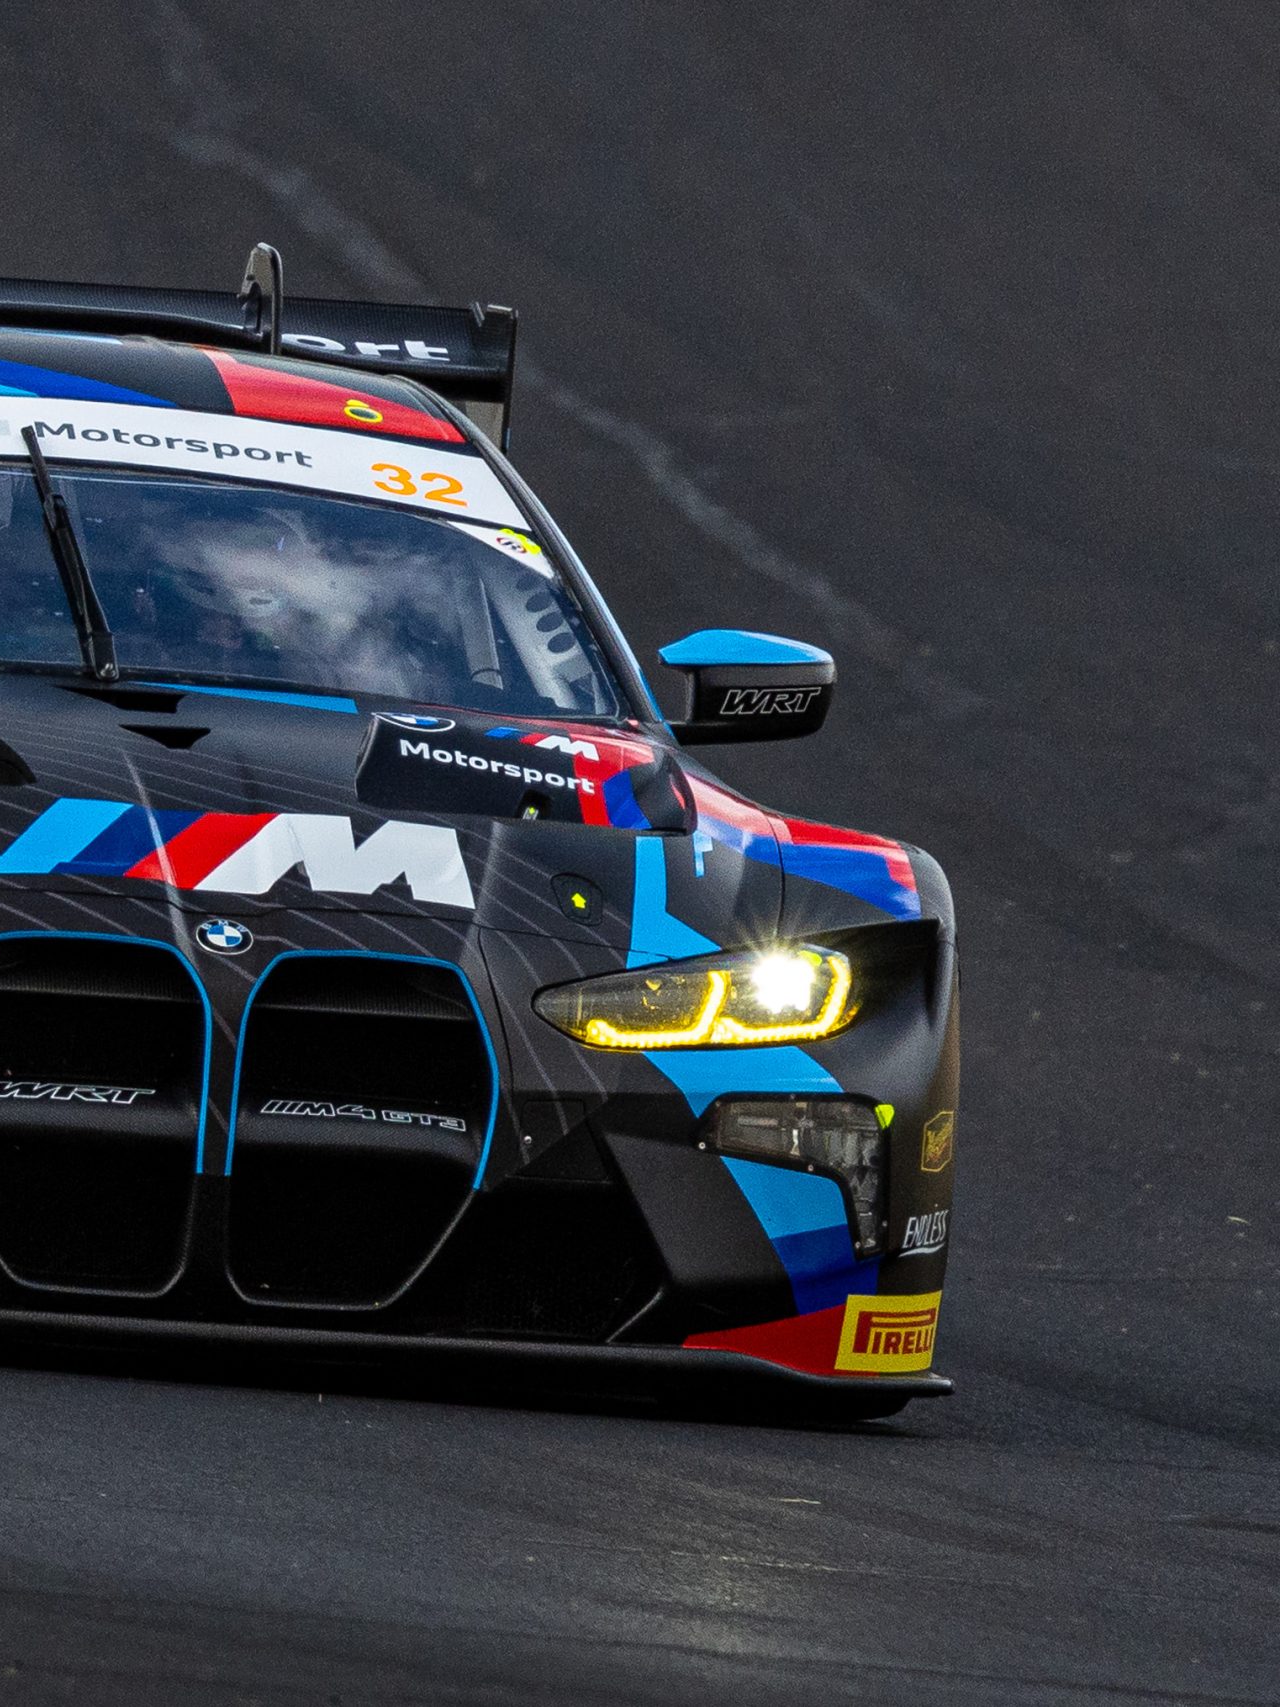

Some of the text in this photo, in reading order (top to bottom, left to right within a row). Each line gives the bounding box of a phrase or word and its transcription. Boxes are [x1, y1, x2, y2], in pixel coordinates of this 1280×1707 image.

[35, 421, 313, 468] Motorsport
[370, 463, 468, 507] 32
[720, 686, 822, 715] WRT
[399, 739, 595, 795] Motorsport
[192, 813, 477, 910] M
[382, 1110, 467, 1132] GT3
[901, 1209, 949, 1249] ENDLESS
